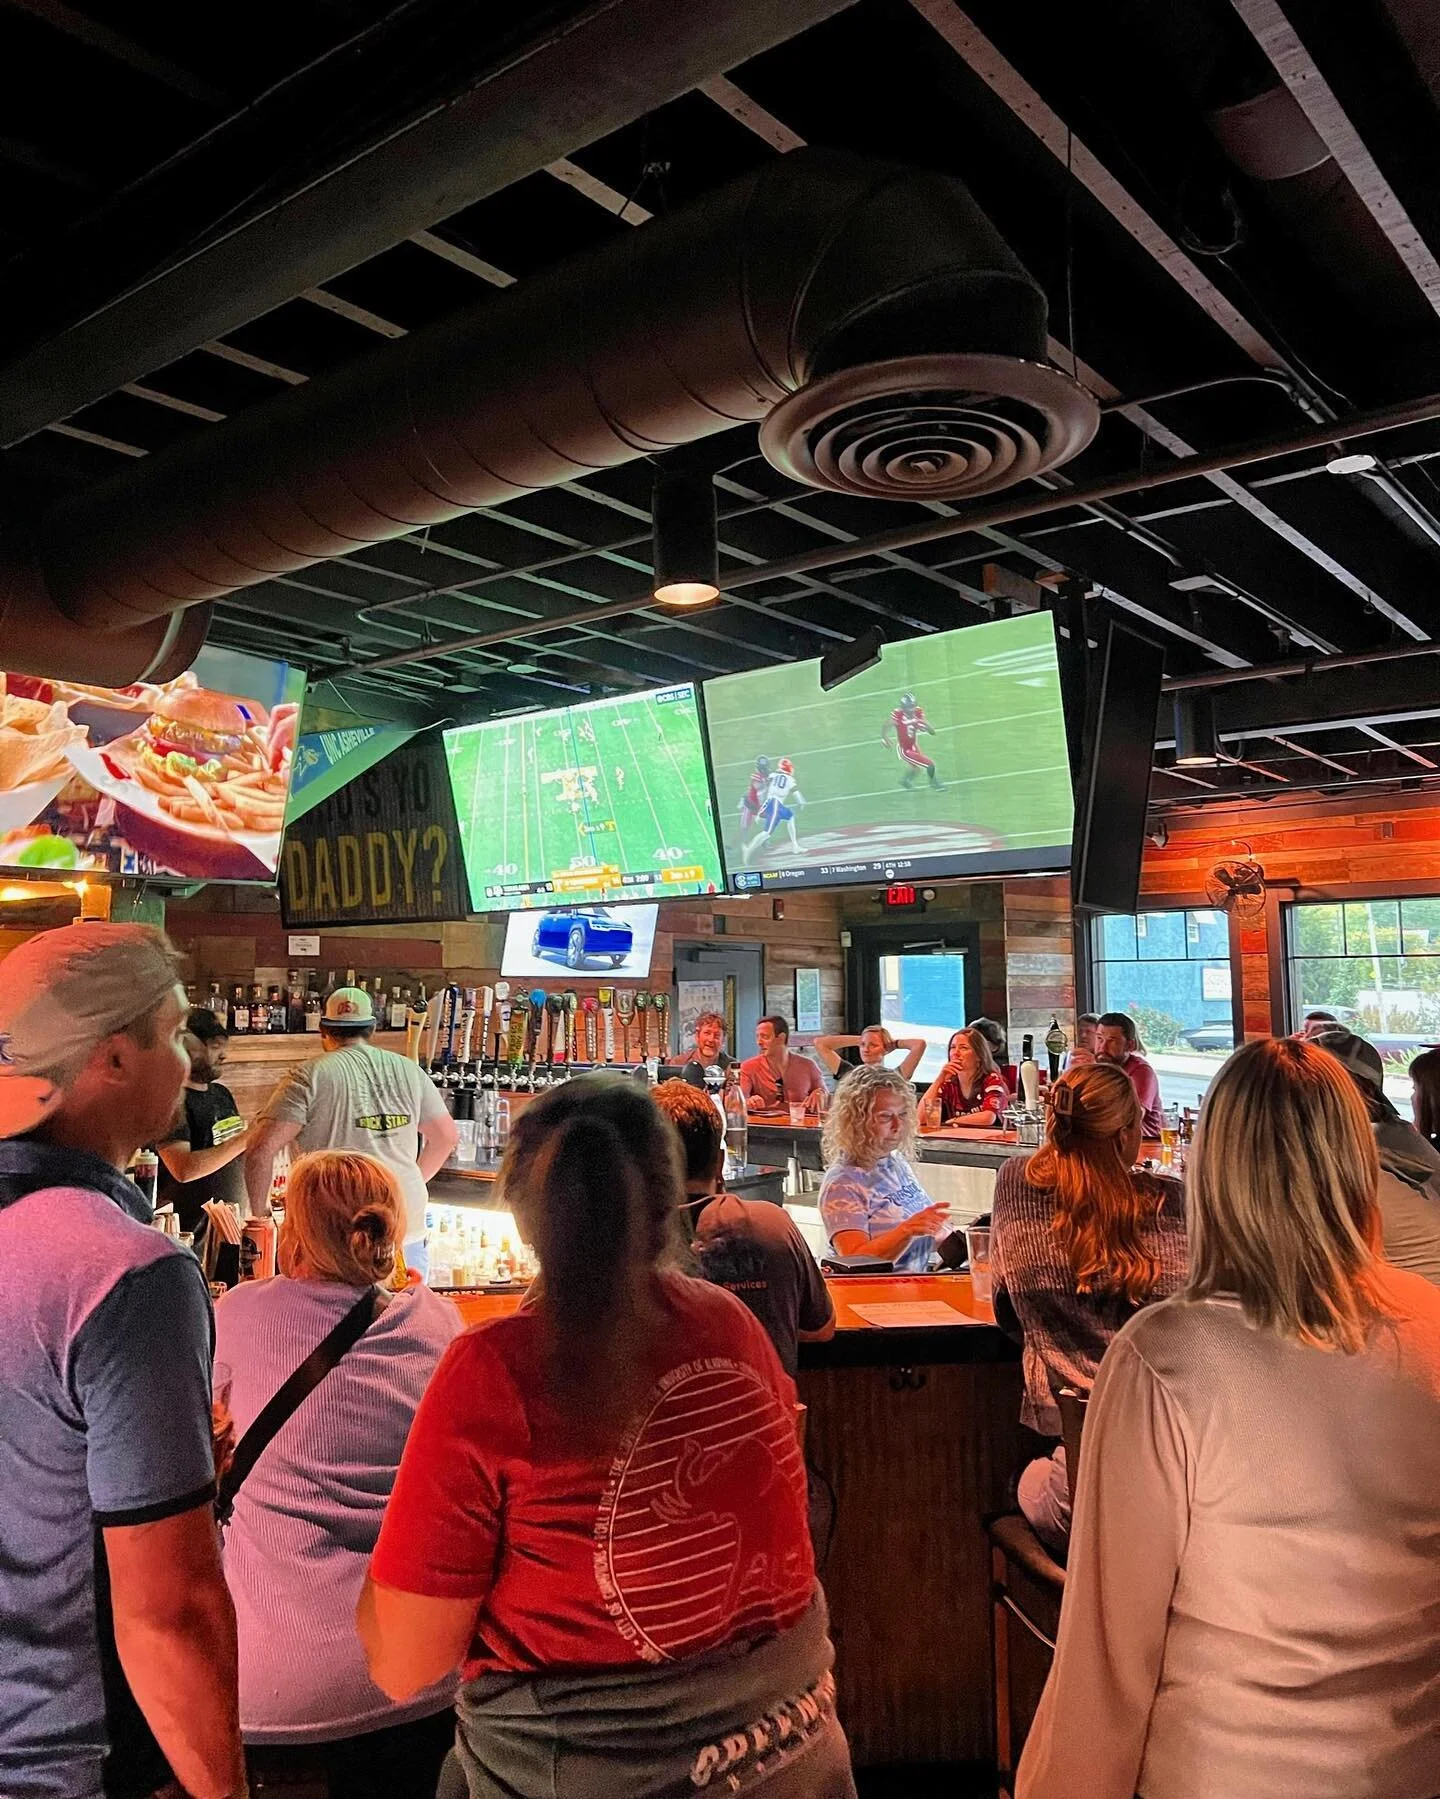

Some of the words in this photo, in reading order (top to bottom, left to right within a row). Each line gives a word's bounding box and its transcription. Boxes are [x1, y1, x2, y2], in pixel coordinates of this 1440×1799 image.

[337, 727, 376, 756] ASHEVILLE
[285, 824, 448, 911] DADDY?
[785, 870, 805, 878] Oregon
[836, 865, 867, 873] Washington
[385, 1115, 409, 1129] STAR
[598, 1489, 616, 1511] TIDE
